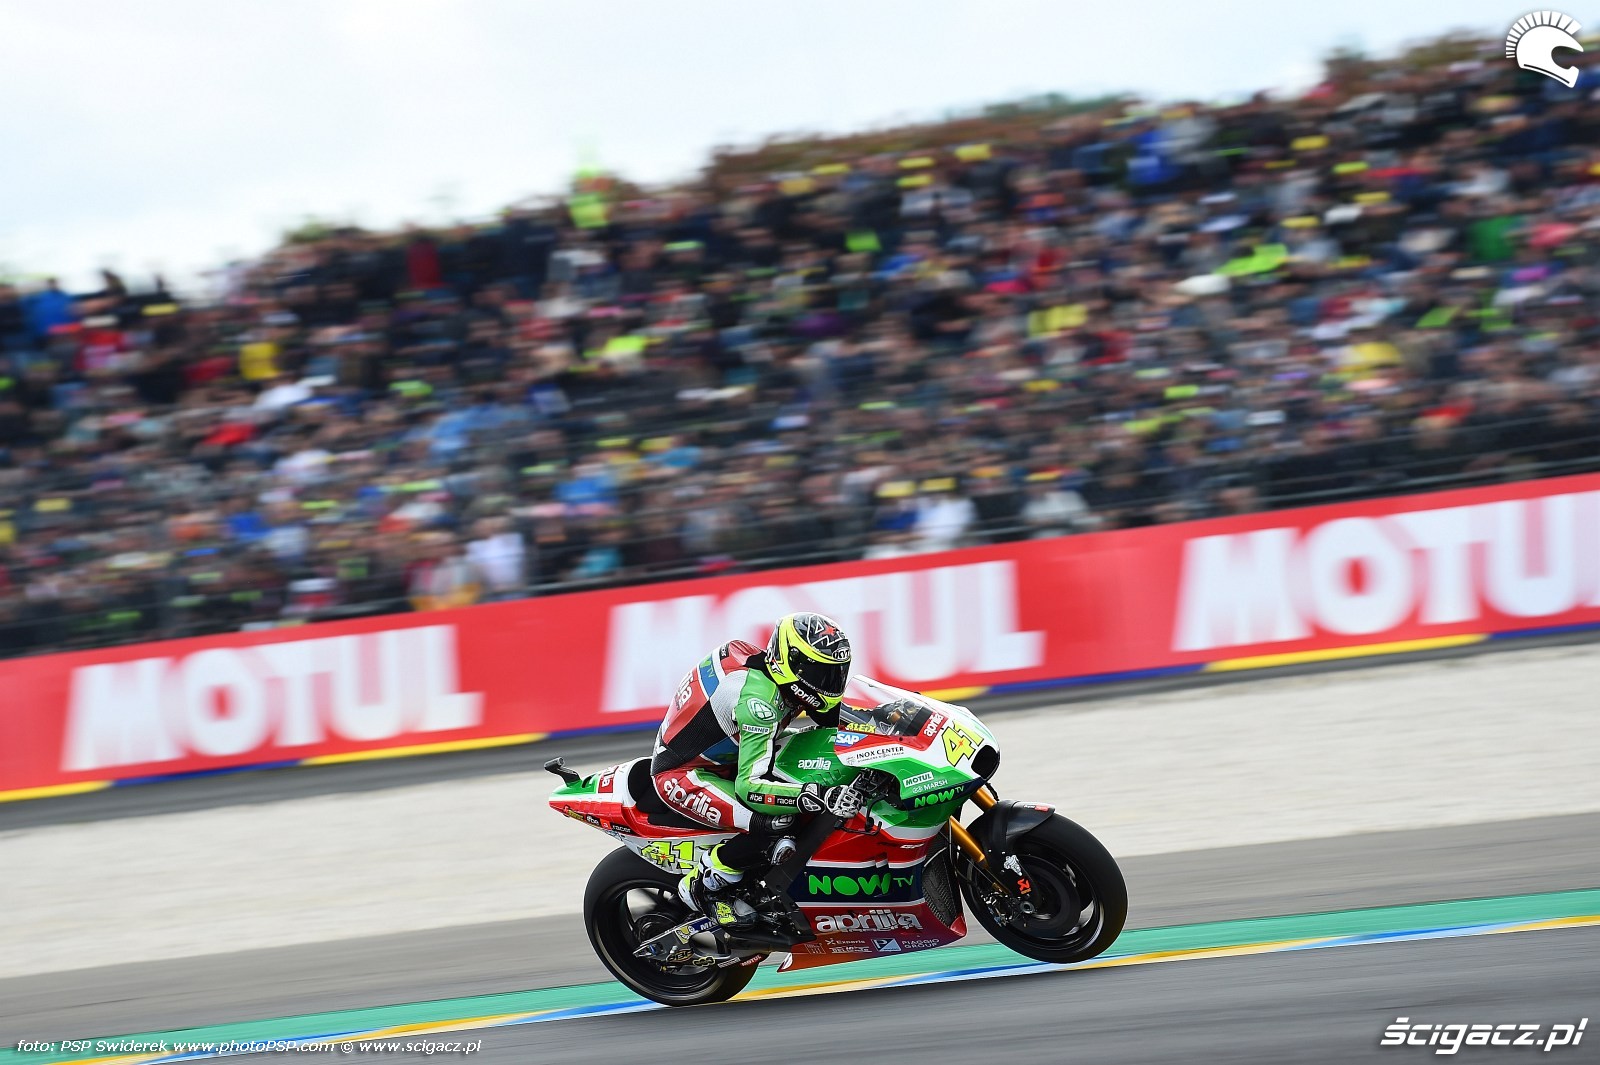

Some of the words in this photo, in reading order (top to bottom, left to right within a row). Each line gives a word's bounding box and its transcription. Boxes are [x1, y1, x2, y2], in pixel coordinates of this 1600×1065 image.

[1172, 490, 1600, 651] MOTU
[61, 625, 485, 771] MOTUL
[790, 683, 821, 708] aprilia
[923, 712, 945, 737] aprilia
[836, 733, 860, 745] SAP
[941, 718, 985, 767] 41
[798, 757, 832, 770] aprilia
[856, 751, 875, 760] INOX
[876, 746, 905, 755] CENTER
[905, 773, 932, 786] MOTUL
[923, 779, 948, 790] MARSH
[663, 778, 722, 825] aprilia
[776, 797, 796, 805] racer
[914, 788, 955, 808] NOW
[640, 840, 695, 869] 41
[808, 873, 892, 896] NOW
[893, 875, 914, 888] TV
[814, 909, 923, 933] aprilia
